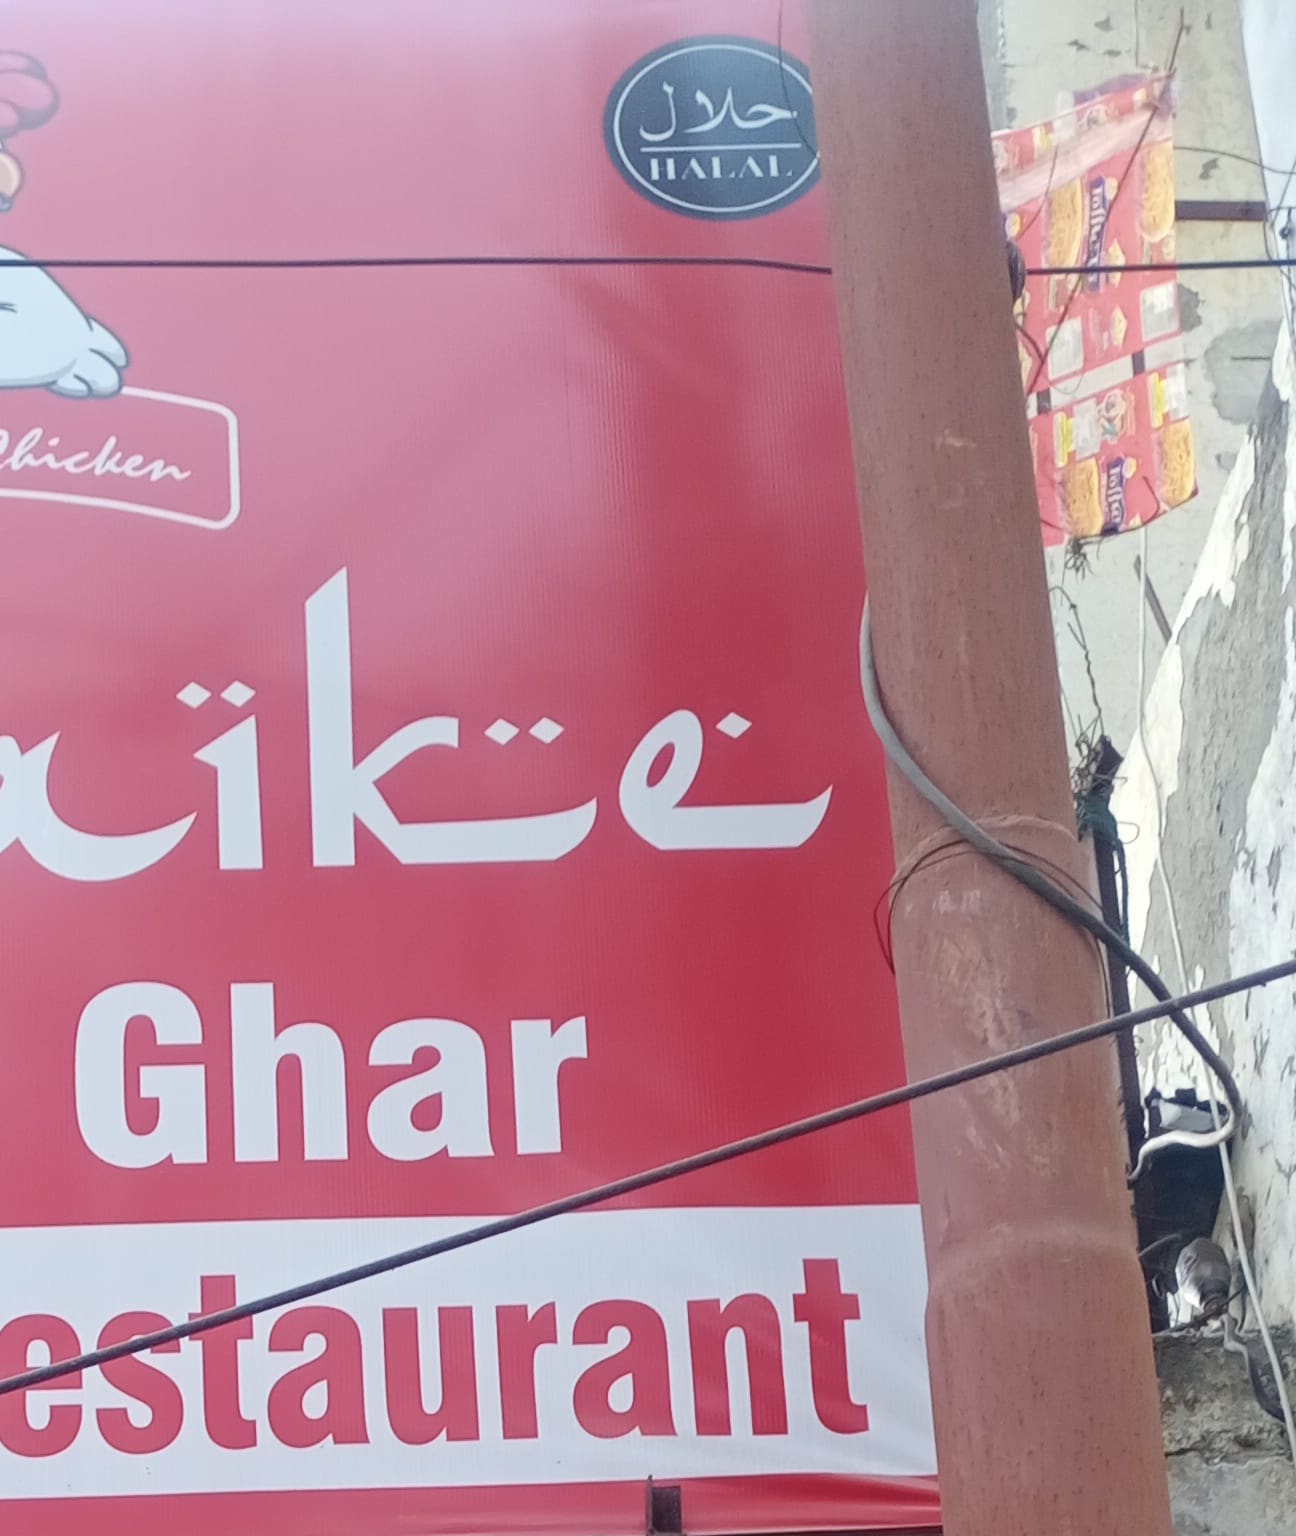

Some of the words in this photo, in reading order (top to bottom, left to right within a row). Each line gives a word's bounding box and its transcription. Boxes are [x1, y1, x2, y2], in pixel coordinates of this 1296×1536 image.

[639, 80, 798, 141] حلال
[650, 155, 793, 180] HALAL
[74, 981, 588, 1169] Ghar
